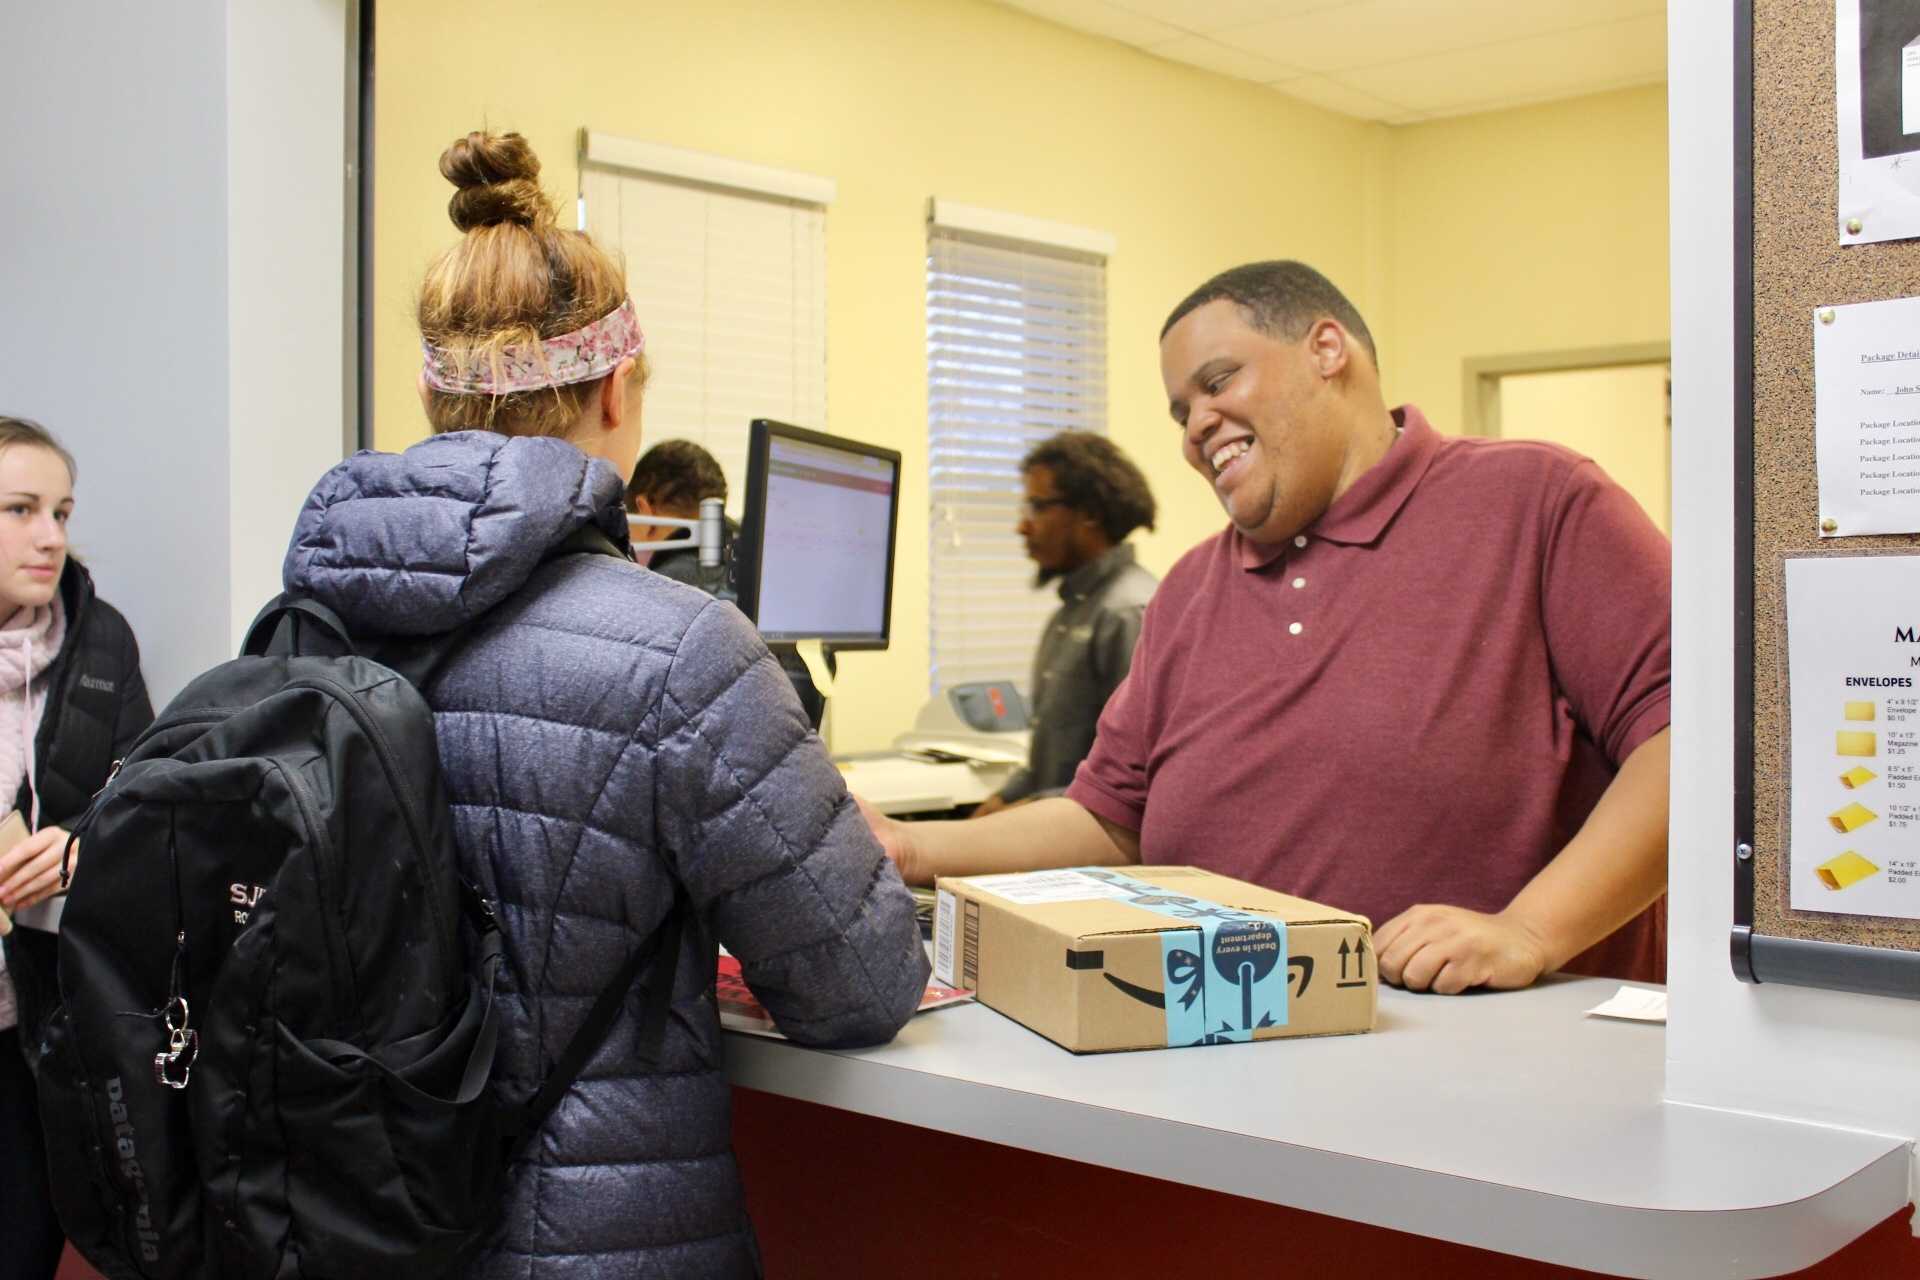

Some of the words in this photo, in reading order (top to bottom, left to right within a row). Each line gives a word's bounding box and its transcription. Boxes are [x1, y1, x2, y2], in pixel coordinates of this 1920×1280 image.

[1860, 353, 1895, 362] Package
[1895, 385, 1914, 394] John
[1860, 421, 1890, 429] Package
[1860, 438, 1890, 446] Package
[1860, 455, 1890, 463] Package
[1860, 471, 1890, 479] Package
[1860, 488, 1890, 497] Package
[1894, 626, 1920, 643] M
[1845, 677, 1912, 688] ENVELOPES
[1887, 706, 1916, 714] Envelope
[1887, 740, 1918, 748] Magazine
[230, 883, 266, 908] SJ
[234, 910, 250, 924] RO
[1220, 932, 1272, 944] department
[1216, 945, 1241, 954] every
[1242, 944, 1251, 953] in
[1253, 942, 1277, 951] Deals
